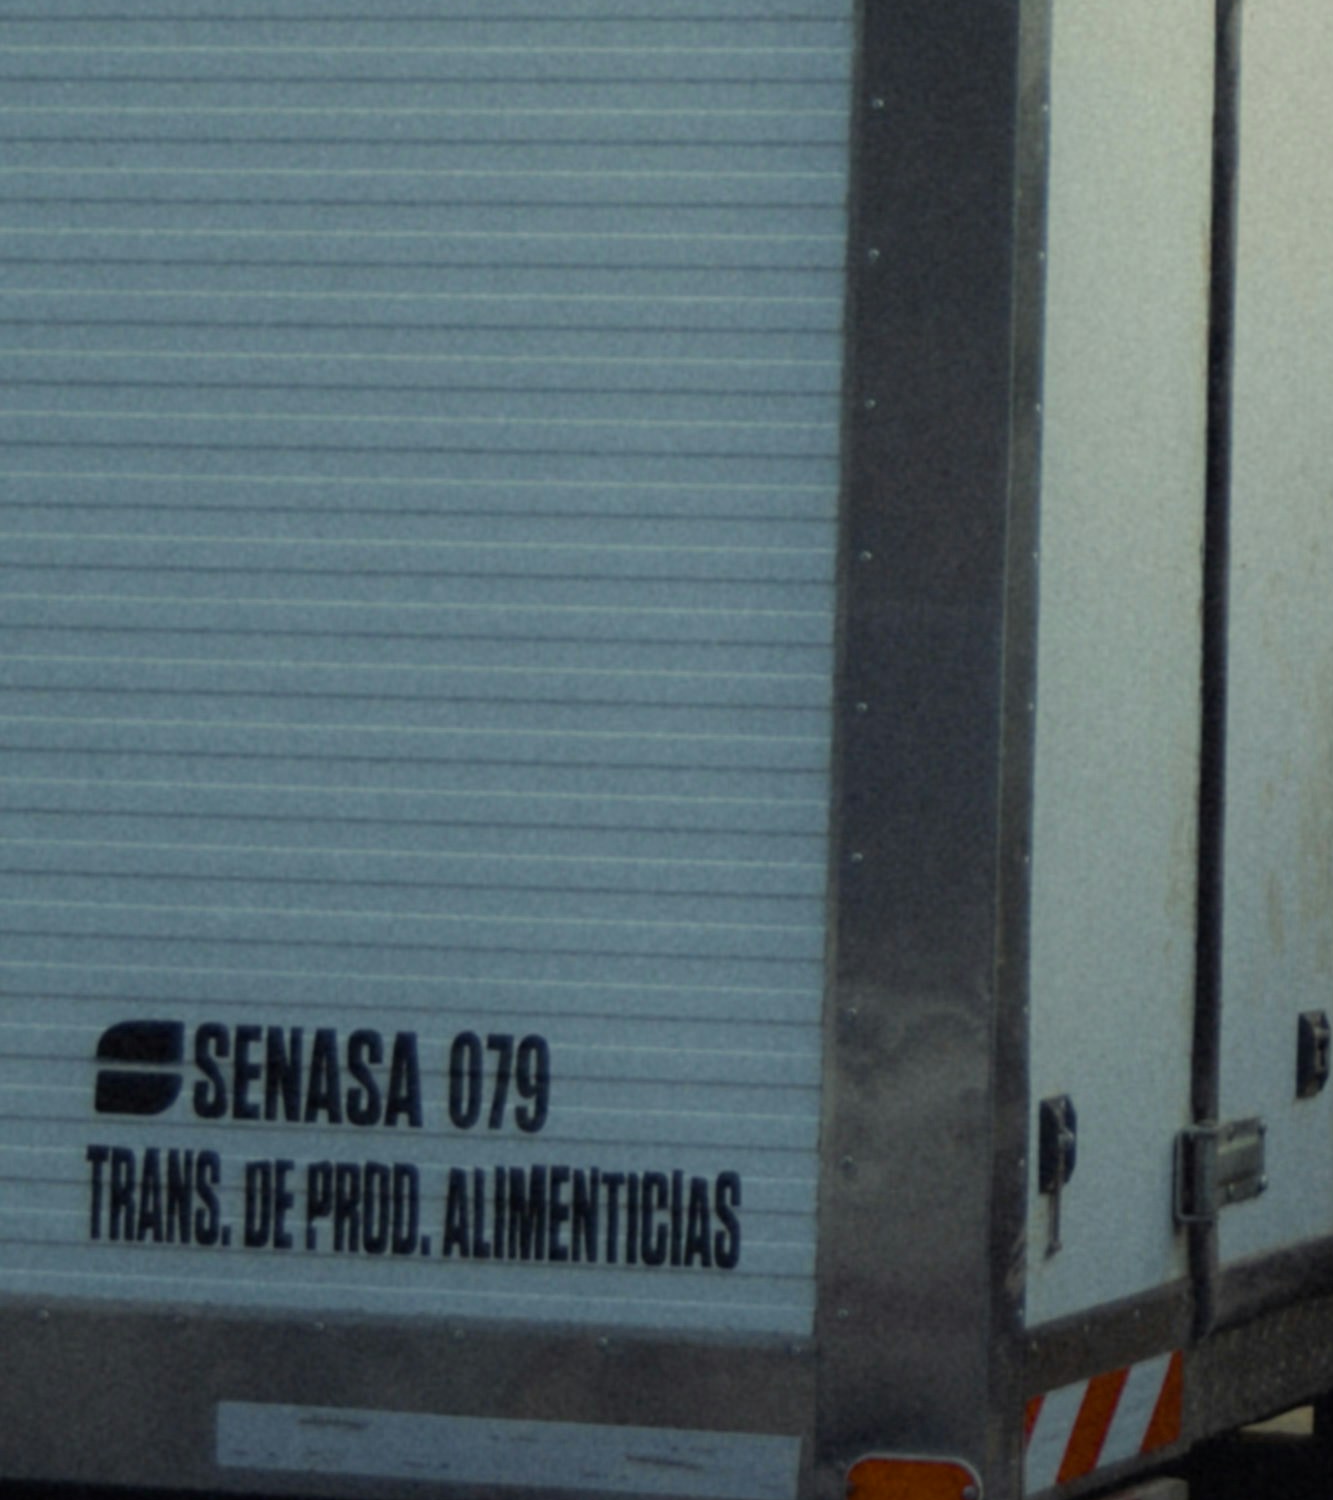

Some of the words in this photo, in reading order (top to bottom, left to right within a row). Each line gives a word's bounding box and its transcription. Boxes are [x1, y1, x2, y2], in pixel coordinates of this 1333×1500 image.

[192, 1021, 424, 1129] SENASA
[448, 1030, 551, 1133] 079
[87, 1144, 232, 1248] TRANS.
[243, 1159, 296, 1250] DE
[305, 1159, 432, 1257] PROD.
[442, 1165, 743, 1271] ALIMENTICIAS
